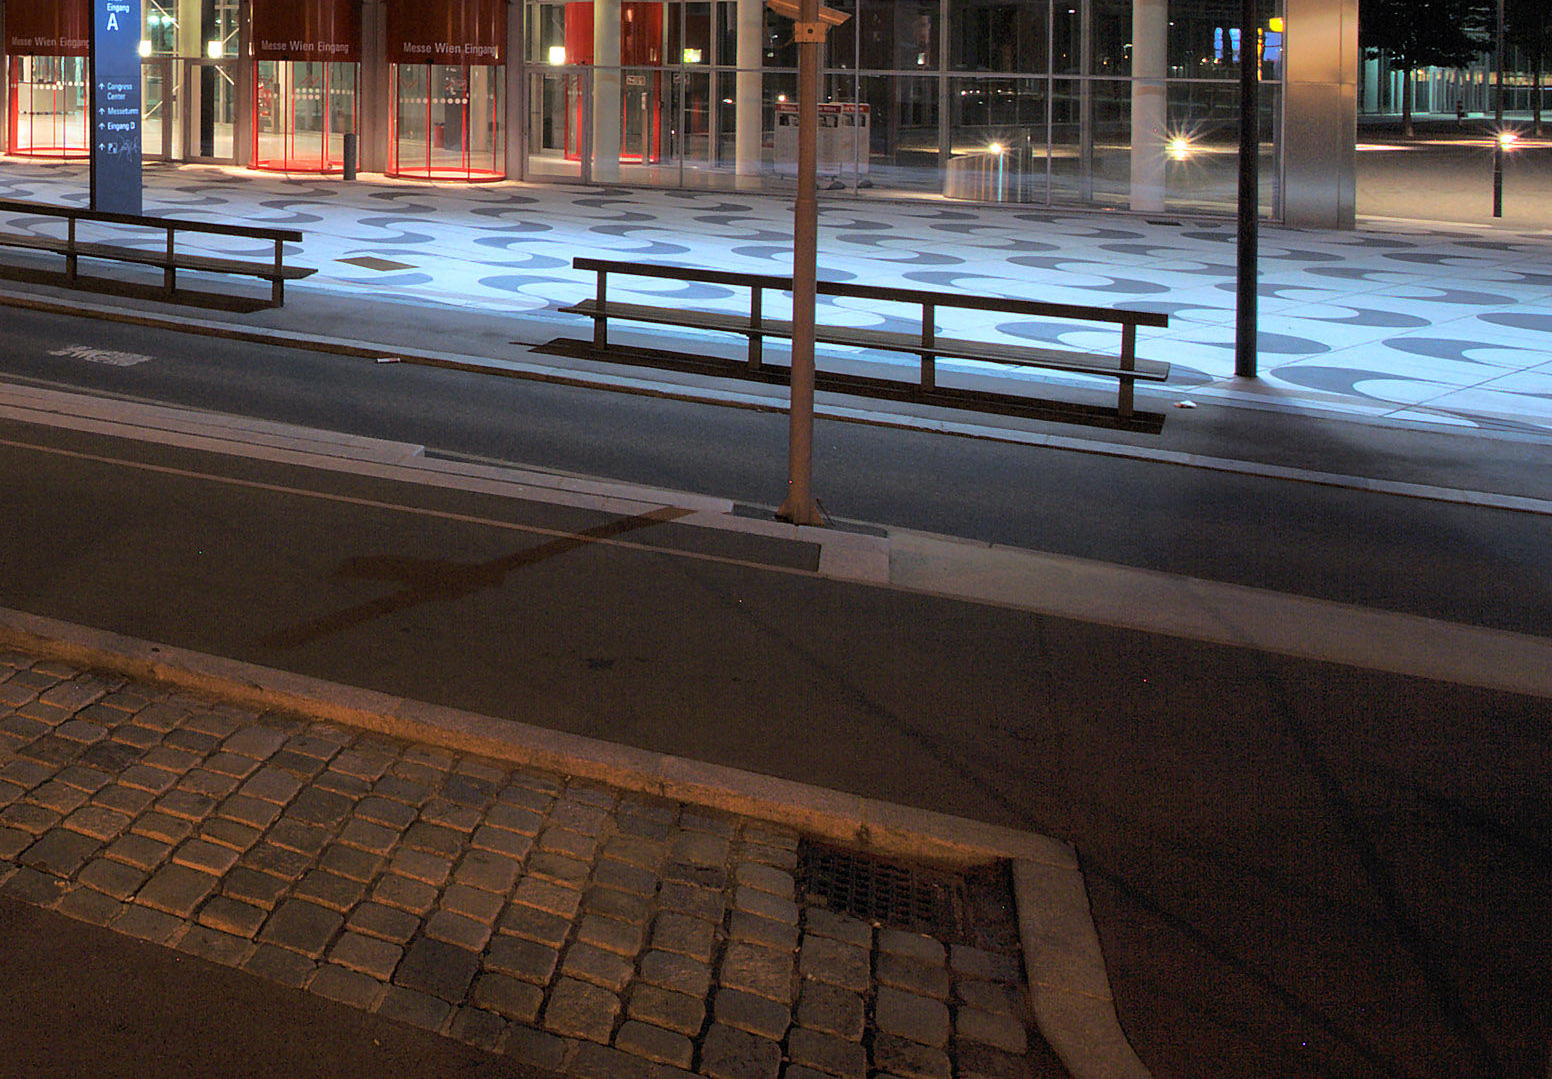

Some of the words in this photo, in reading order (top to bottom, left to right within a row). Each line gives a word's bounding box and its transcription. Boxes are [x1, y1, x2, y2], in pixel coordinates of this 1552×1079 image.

[107, 3, 130, 13] Eingang
[107, 13, 118, 31] A
[12, 37, 32, 46] Messe
[35, 37, 56, 47] Wien
[262, 40, 287, 50] Messe
[290, 41, 314, 51] Wien
[318, 41, 349, 54] Eingang
[403, 42, 432, 53] Messe
[435, 42, 461, 54] Wien
[465, 43, 497, 57] Eingang
[107, 82, 133, 92] Congress
[107, 92, 126, 100] Center
[107, 122, 129, 131] Eingang
